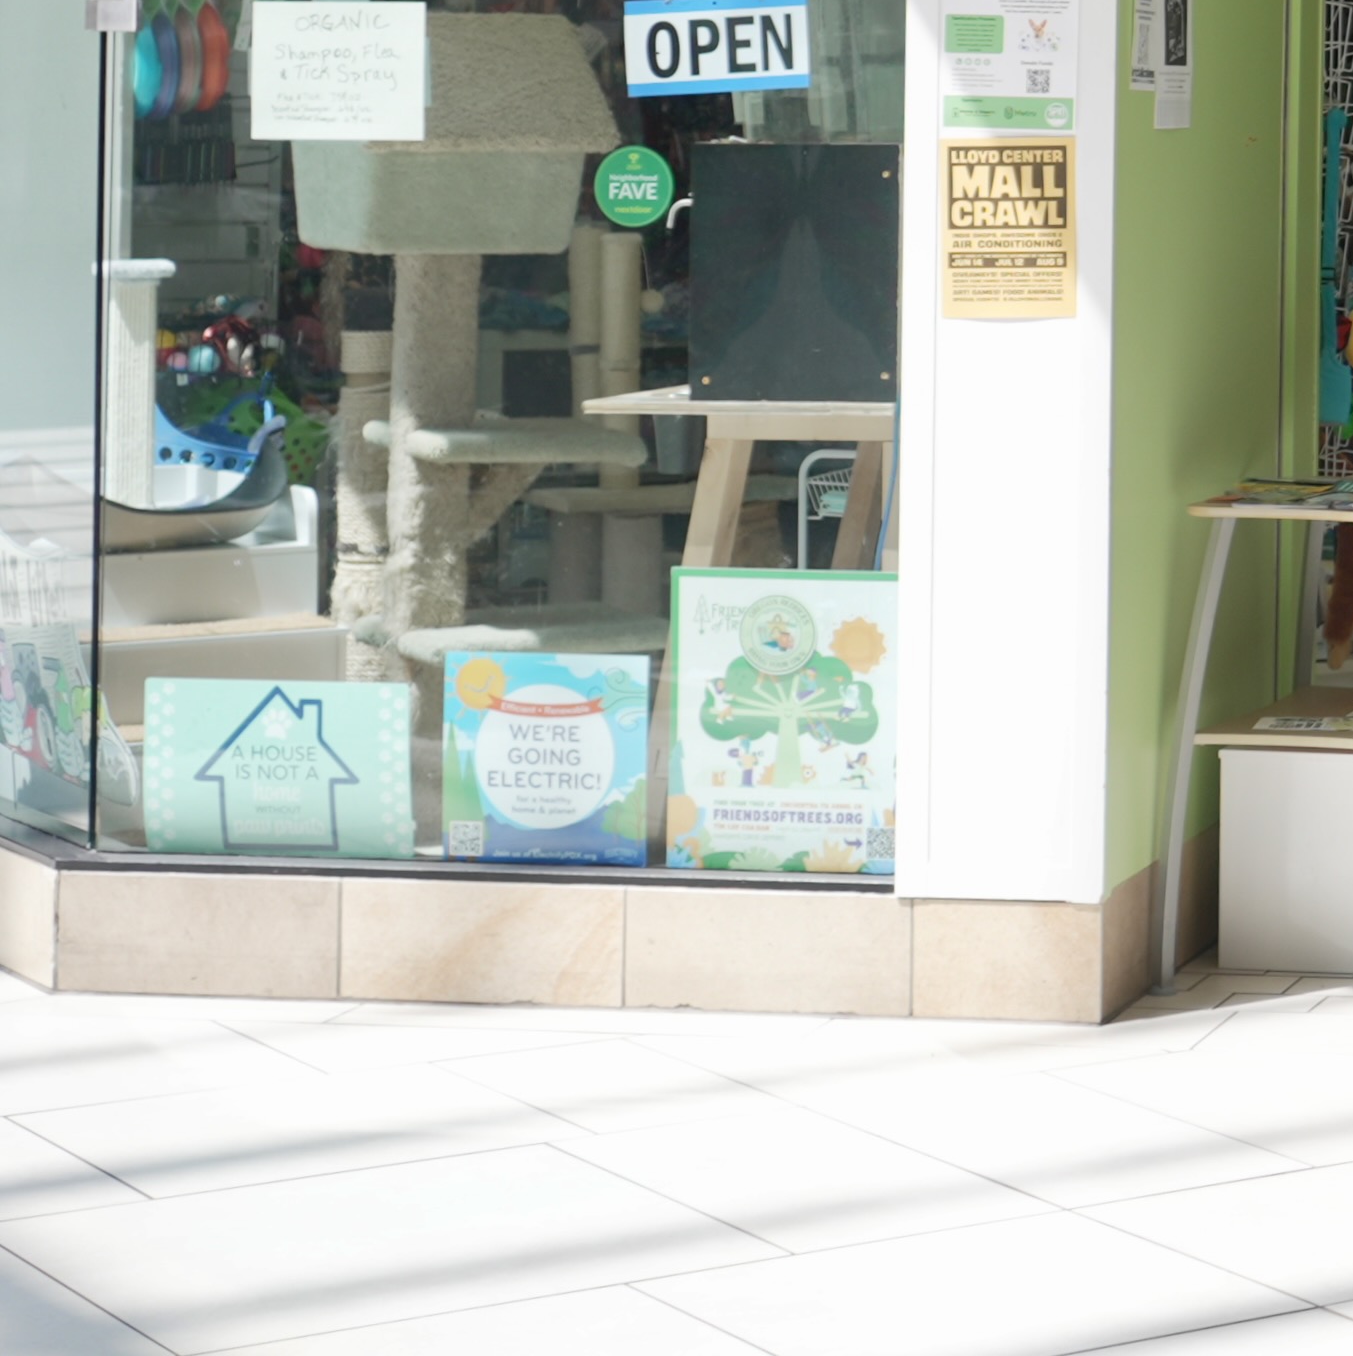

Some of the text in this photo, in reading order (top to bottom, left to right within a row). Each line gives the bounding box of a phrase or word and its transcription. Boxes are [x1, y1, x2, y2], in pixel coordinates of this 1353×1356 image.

[294, 7, 391, 33] ORGANIC
[646, 12, 794, 78] OPEN
[951, 149, 1063, 163] LLOYD CENTER
[951, 164, 1064, 199] MALL
[608, 182, 659, 200] FAVE
[951, 199, 1064, 227] CRAWL
[952, 239, 1062, 248] AIR CONDITIONING
[509, 724, 580, 743] WE'RE
[231, 745, 318, 761] A HOUSE
[507, 748, 581, 765] GOING
[235, 763, 319, 781] IS NOT A
[487, 770, 602, 790] ELECTRIC!
[255, 805, 302, 814] WITHOUT
[713, 809, 863, 825] FRIENDSOFTREES.ORG
